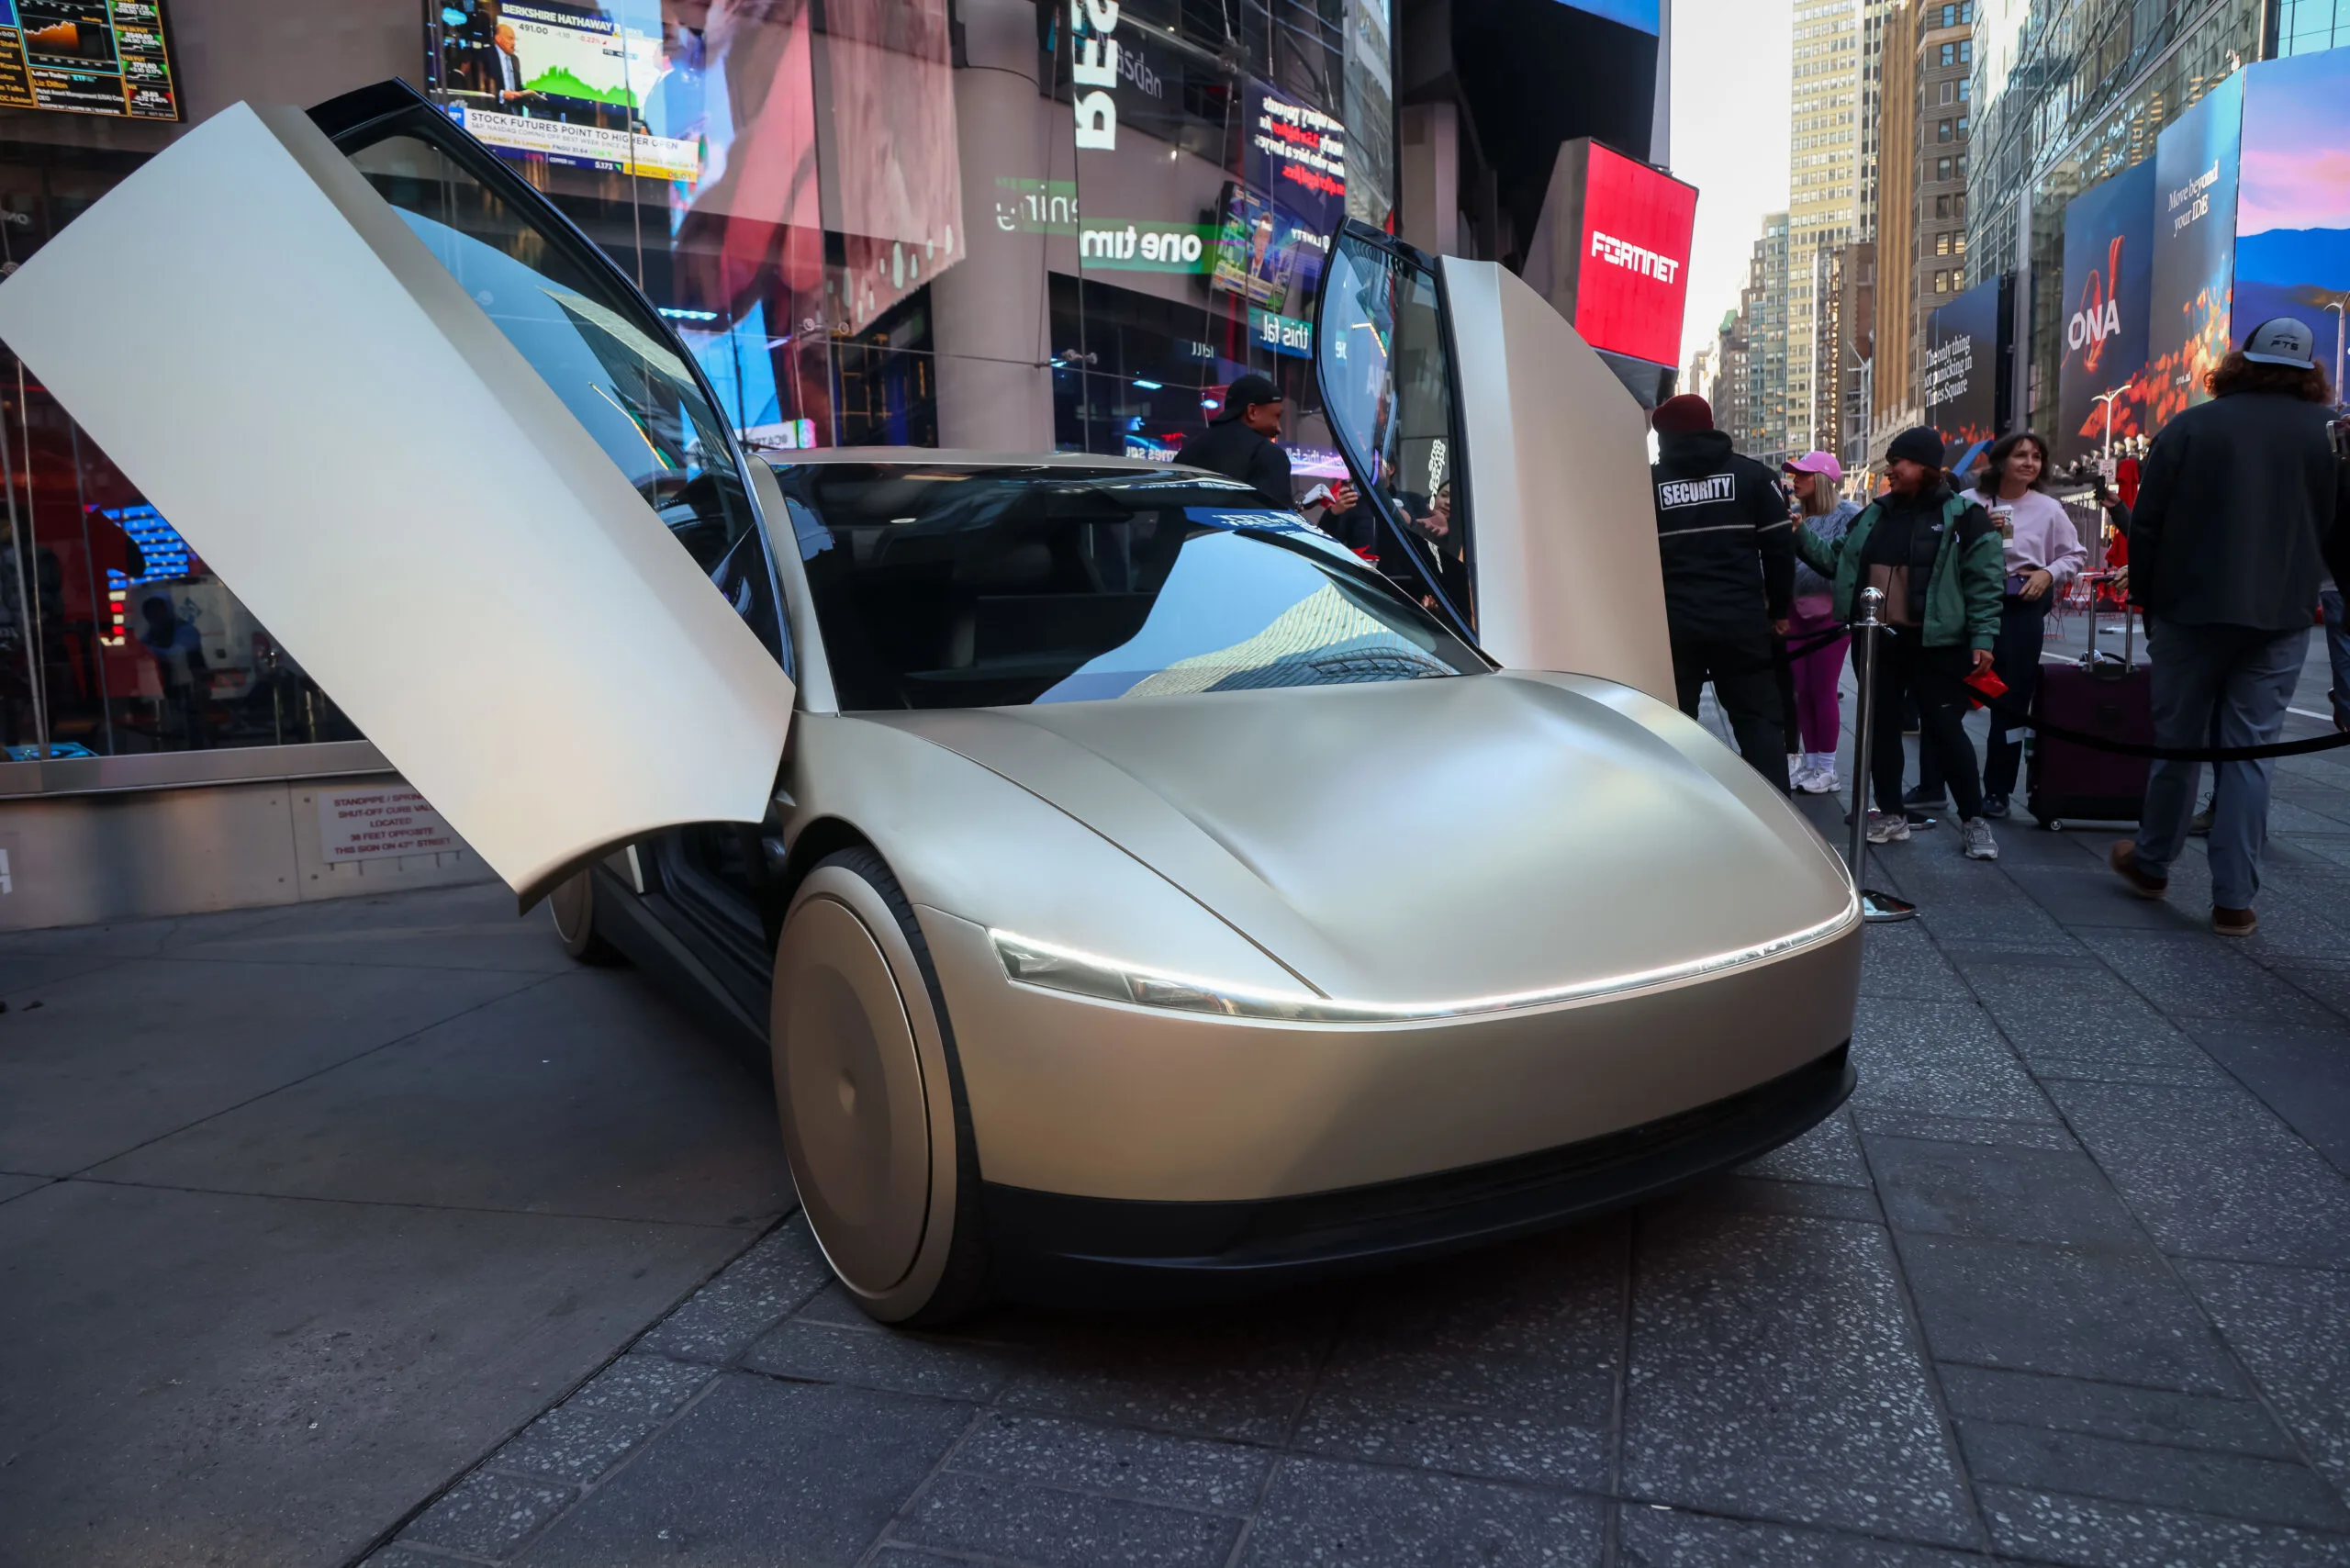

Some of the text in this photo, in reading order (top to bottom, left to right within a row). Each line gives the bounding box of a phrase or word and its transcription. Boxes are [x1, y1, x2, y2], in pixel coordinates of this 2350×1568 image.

[501, 3, 556, 22] BERKSHIRE
[557, 11, 612, 31] HATHAWAY
[613, 23, 621, 33] B
[519, 24, 549, 35] 491.00
[471, 112, 508, 127] STOCK
[510, 118, 558, 132] FUTURES
[562, 126, 592, 138] POINT
[596, 130, 609, 140] TO
[612, 134, 648, 147] HIGHER
[595, 161, 613, 171] 5.173
[2168, 158, 2220, 212] Move beyond
[2174, 193, 2209, 238] your IDE
[1591, 230, 1679, 285] FORTINET
[2067, 299, 2121, 352] ONA
[1925, 334, 1971, 369] The only thing
[2269, 340, 2300, 352] FTS
[1964, 354, 1973, 371] in
[1944, 377, 1968, 403] Square
[1662, 477, 1730, 506] SECURITY
[334, 795, 386, 807] STANDPIPE
[338, 808, 383, 818] SHUT-OFF
[386, 806, 411, 815] CURB
[363, 831, 386, 840] FEET
[388, 827, 434, 838] OPPOSITE
[370, 817, 412, 828] LOCATED
[334, 846, 356, 855] THIS
[358, 844, 380, 853] SIGN
[382, 842, 396, 851] ON
[417, 837, 451, 847] STREET
